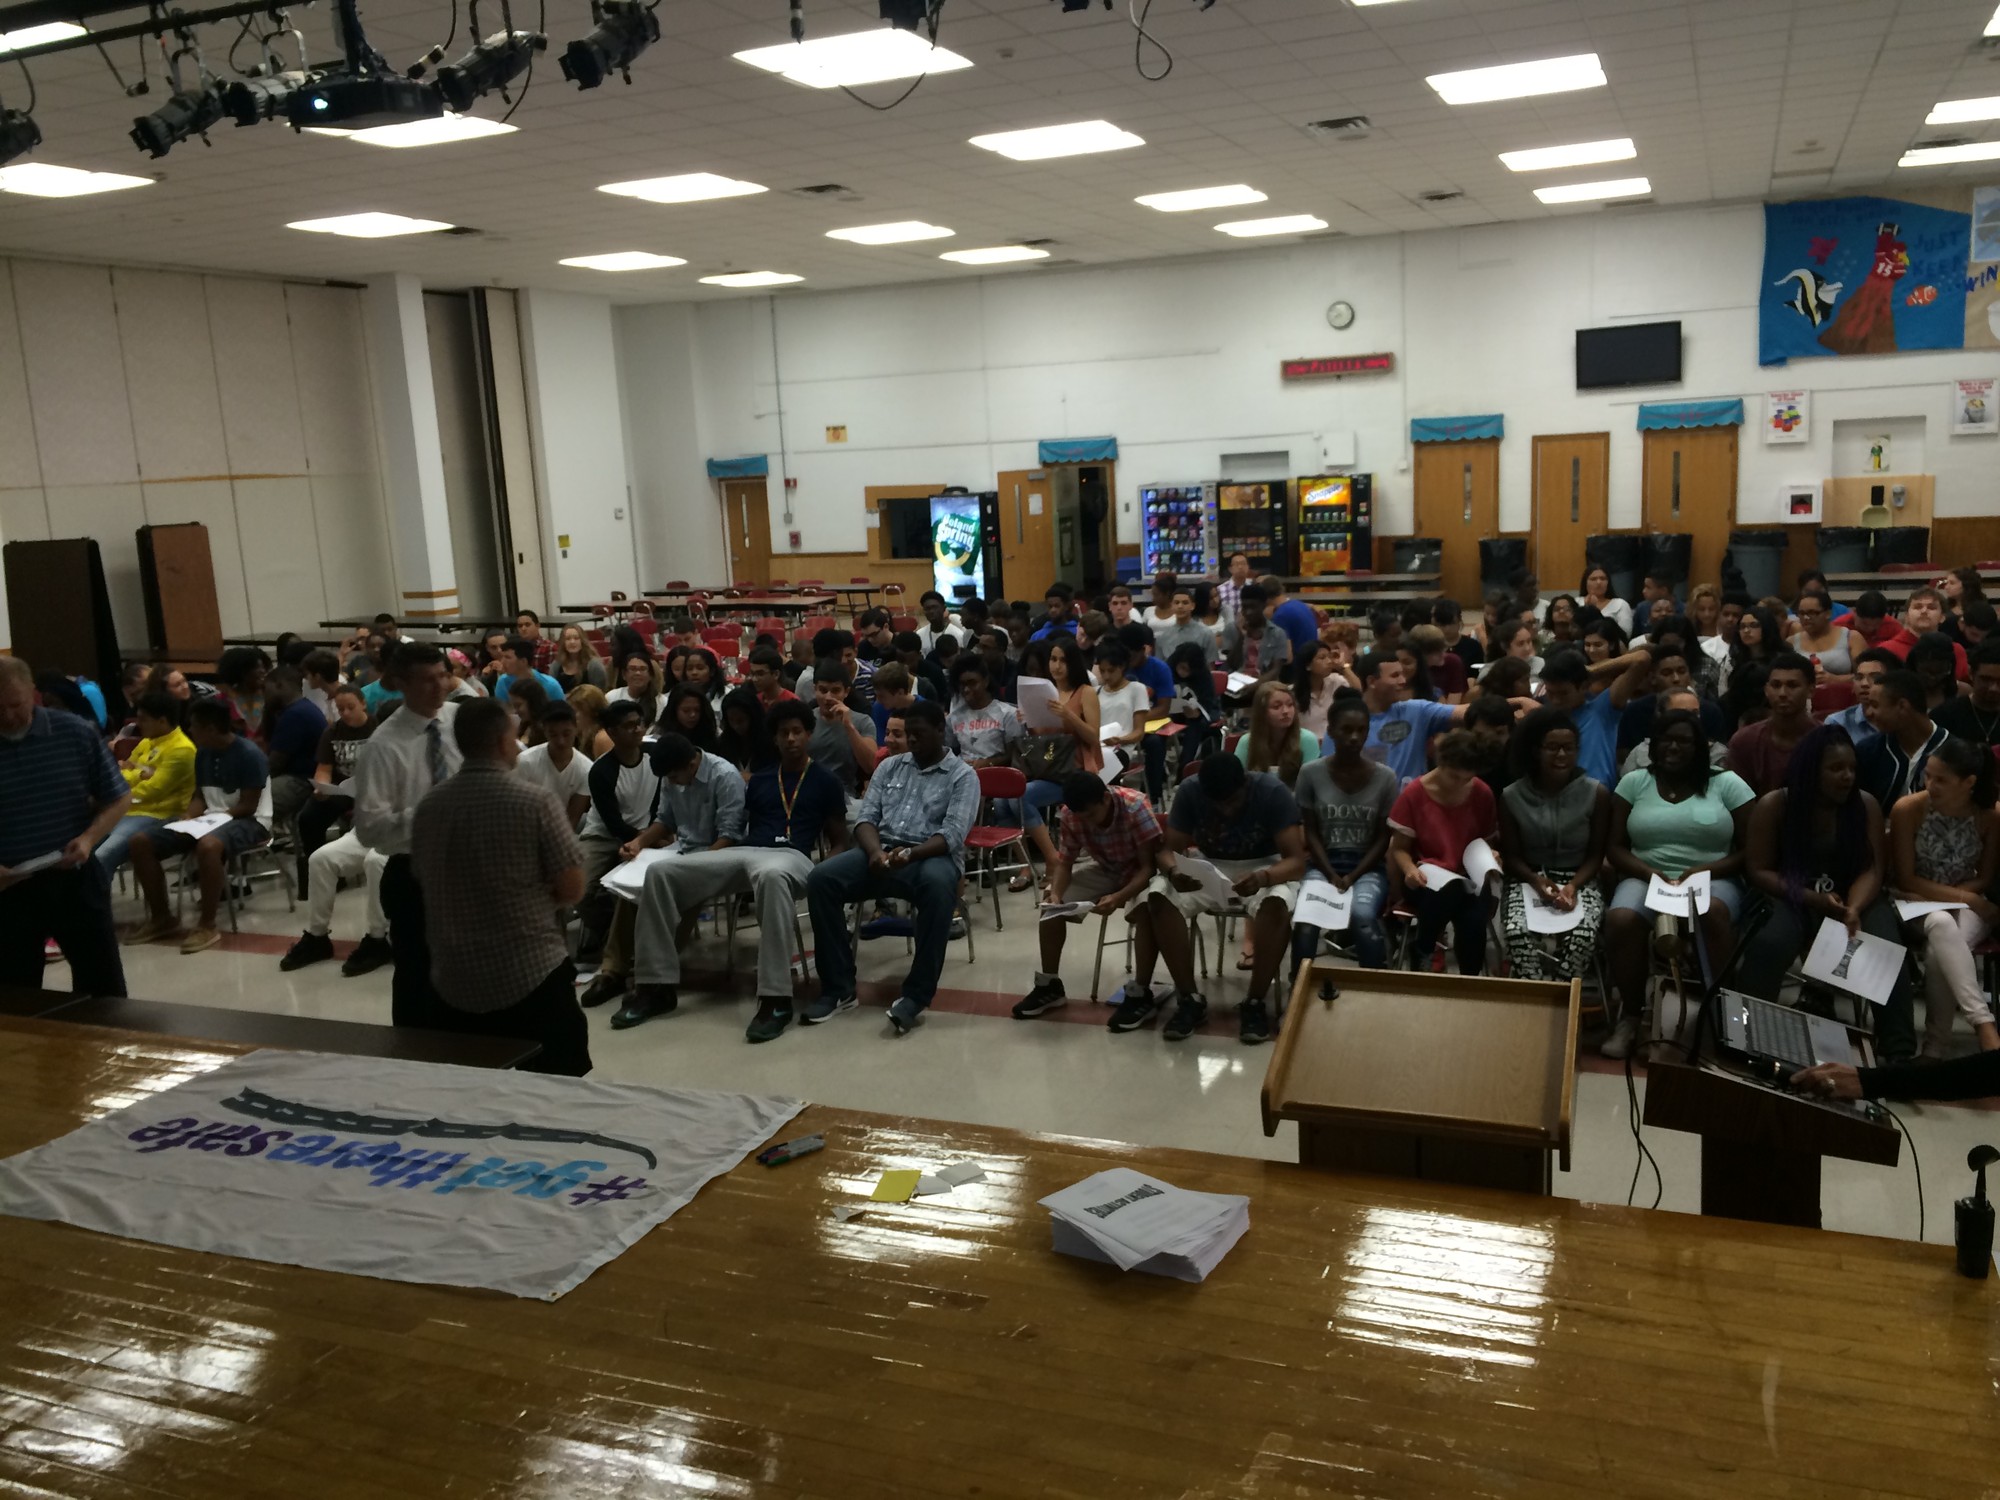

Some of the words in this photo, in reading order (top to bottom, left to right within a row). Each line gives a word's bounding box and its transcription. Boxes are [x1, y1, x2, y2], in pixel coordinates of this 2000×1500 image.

[1915, 231, 1963, 252] JUST
[1913, 255, 1962, 276] KEEP
[1307, 484, 1342, 504] Snapple
[941, 513, 976, 533] Poland
[936, 522, 976, 552] Spring
[127, 1117, 647, 1205] #gettheresafe
